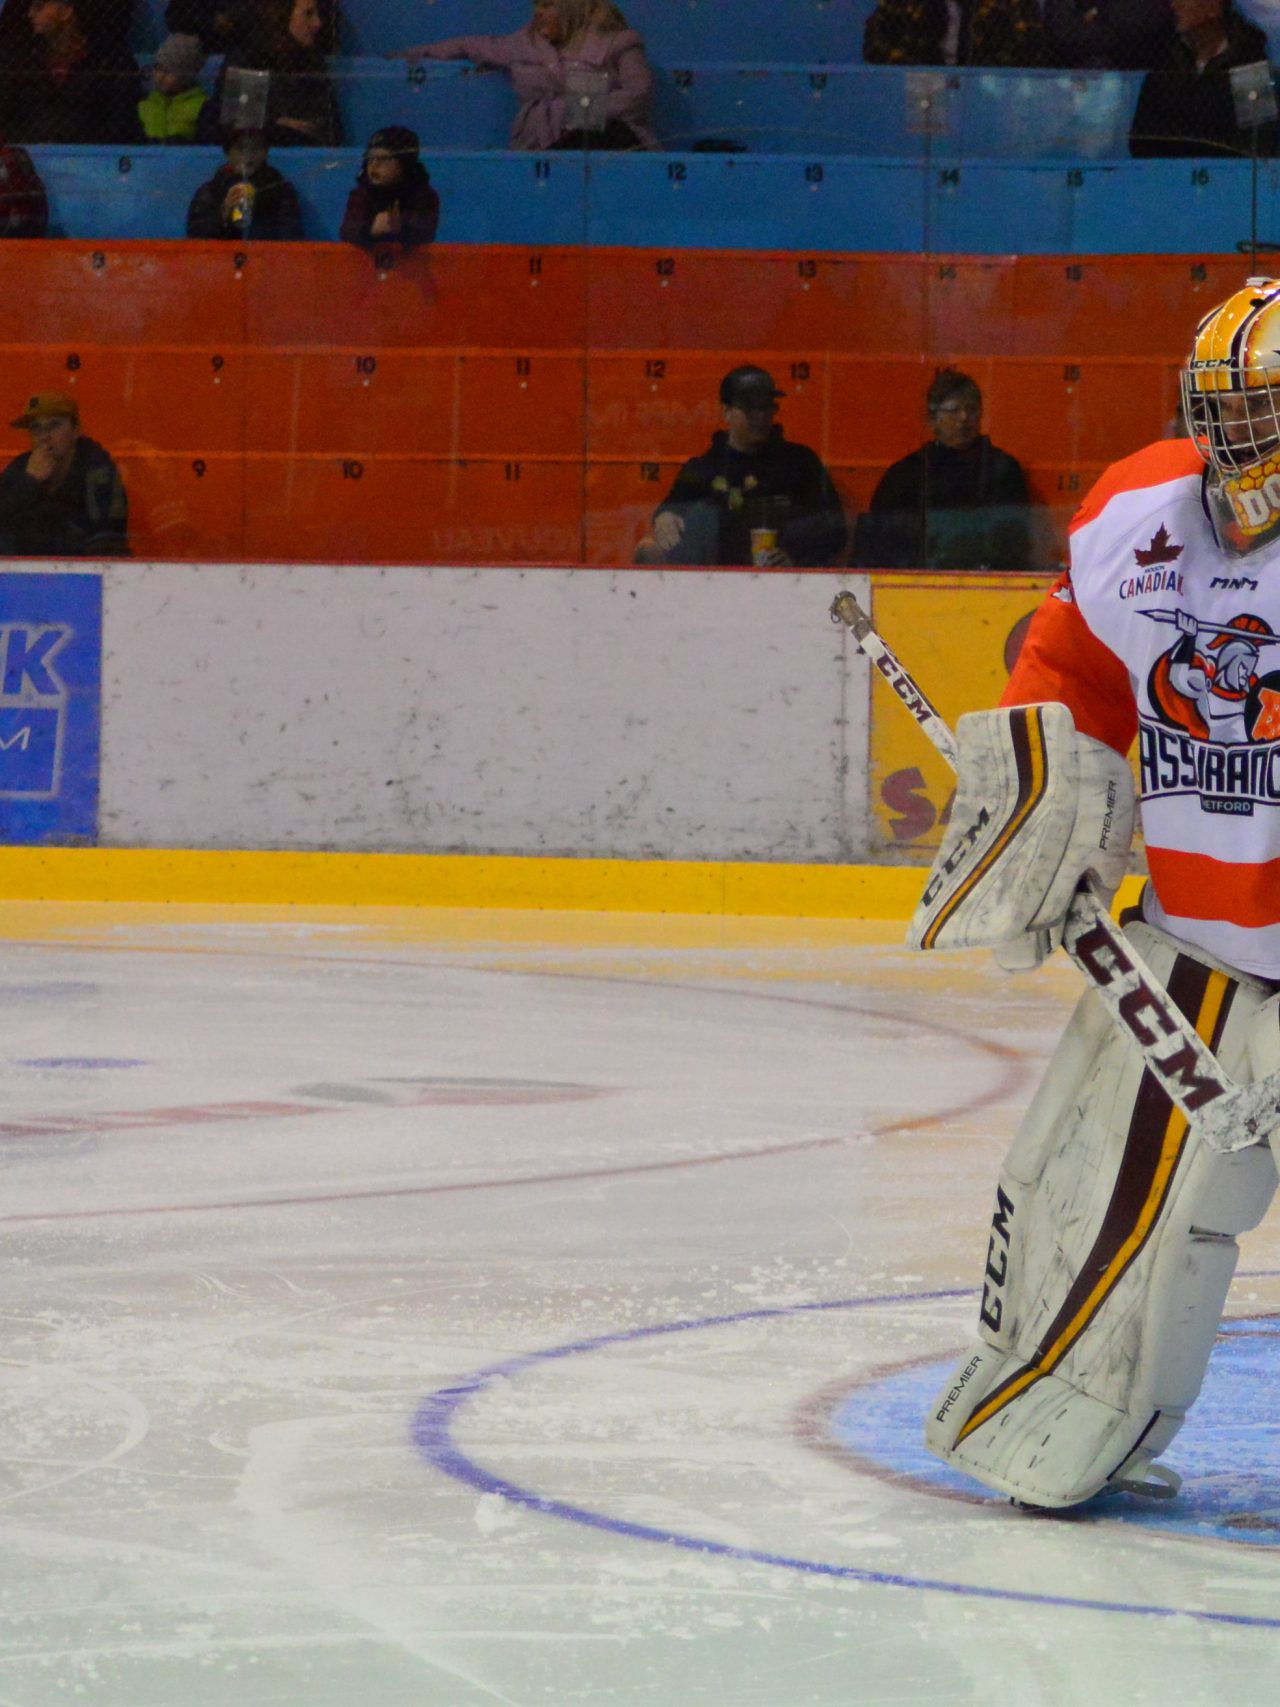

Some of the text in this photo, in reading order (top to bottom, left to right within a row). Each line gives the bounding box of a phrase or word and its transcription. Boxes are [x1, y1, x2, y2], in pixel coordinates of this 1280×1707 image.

[536, 161, 549, 177] 11
[668, 162, 686, 180] 12
[529, 257, 541, 275] 11
[67, 354, 81, 371] 8
[211, 354, 223, 372] 9
[355, 356, 376, 374] 10
[516, 357, 530, 375] 11
[645, 360, 666, 378] 12
[790, 362, 809, 380] 13
[1194, 359, 1236, 370] CCM
[192, 459, 206, 478] 9
[343, 461, 363, 480] 10
[504, 463, 520, 481] 11
[640, 463, 660, 482] 12
[876, 654, 933, 725] CCM
[881, 767, 957, 840] S
[1202, 800, 1252, 814] ETFORD
[1098, 780, 1118, 851] PREMIER
[920, 806, 991, 908] CCM
[1074, 914, 1227, 1113] CCM
[980, 1183, 1015, 1333] CCM
[936, 1355, 983, 1423] PREMIER
